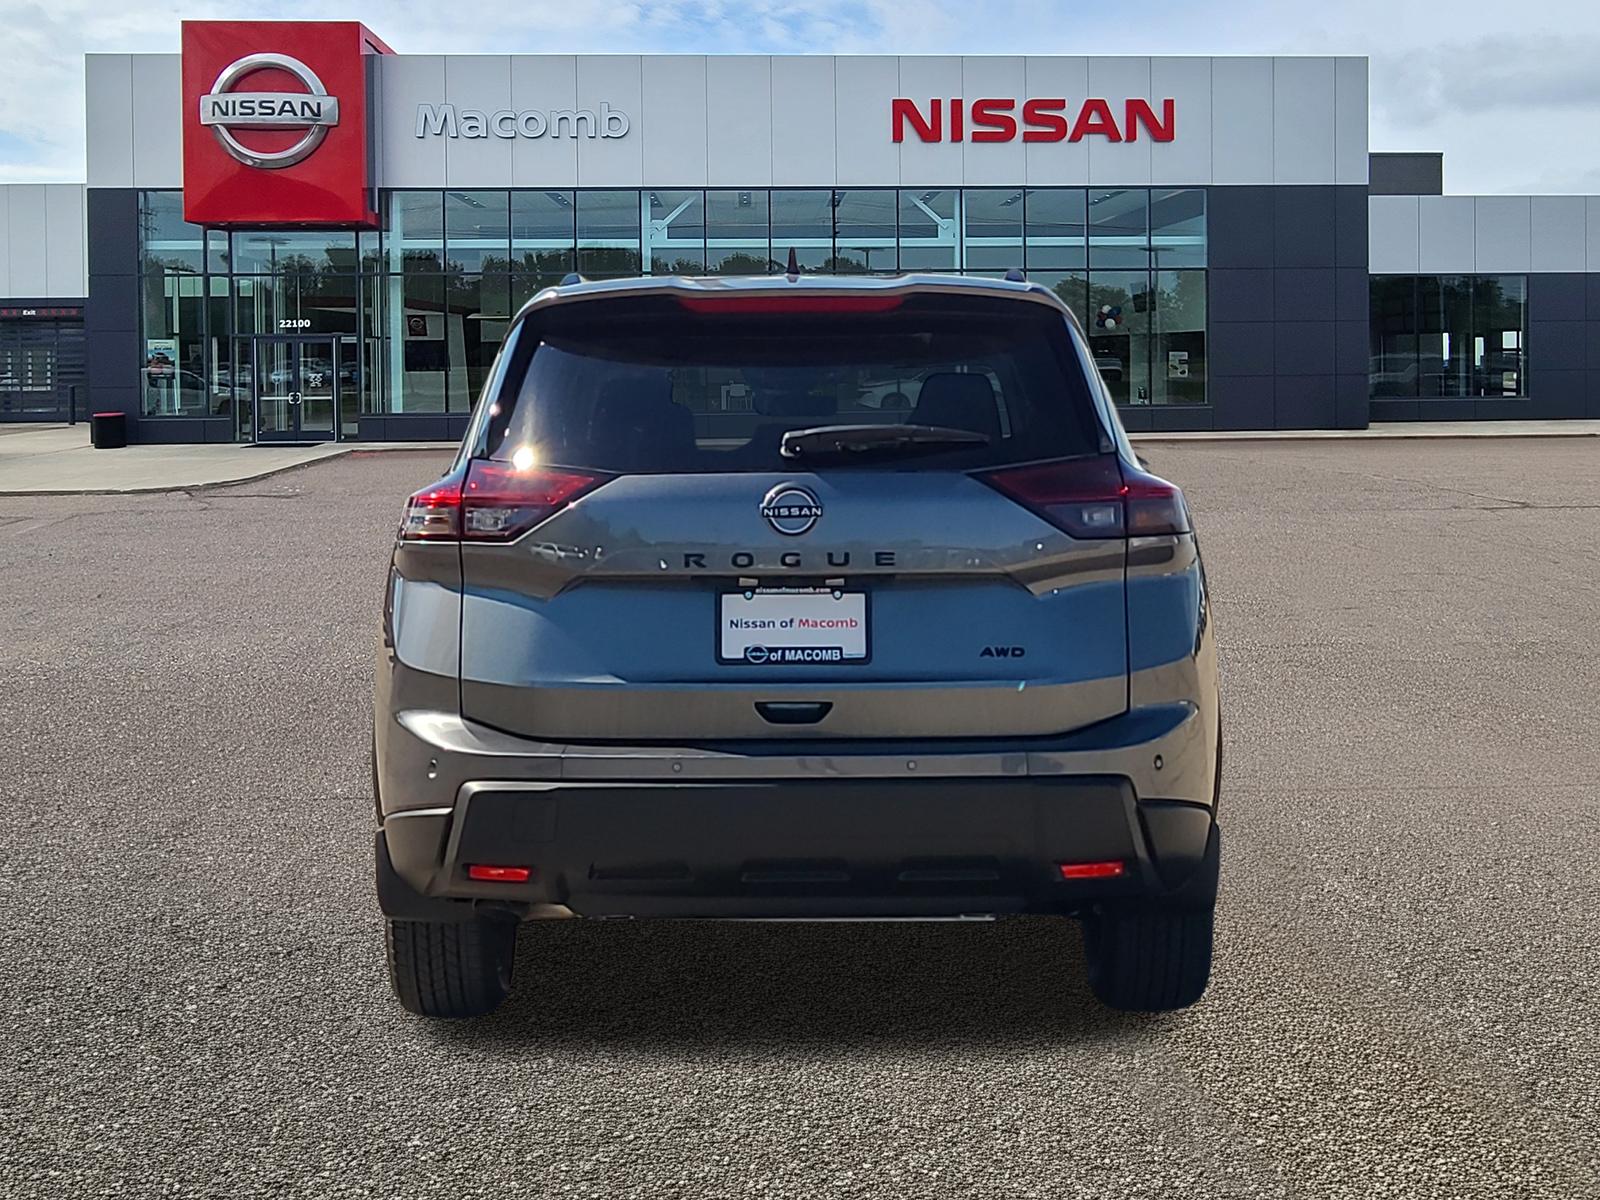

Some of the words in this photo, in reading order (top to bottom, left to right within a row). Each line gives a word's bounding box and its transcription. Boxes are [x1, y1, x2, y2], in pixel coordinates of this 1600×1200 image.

[212, 100, 322, 117] NISSAN
[415, 102, 630, 139] Macomb
[892, 98, 1175, 142] NISSAN
[279, 319, 311, 328] 22100
[763, 506, 822, 516] NISSAN
[684, 552, 896, 569] ROGUE
[729, 618, 776, 629] Nissan
[779, 618, 794, 629] of
[798, 618, 858, 628] Macomb
[770, 650, 782, 661] of
[785, 650, 841, 661] MACOMB
[980, 646, 1025, 657] AWD
